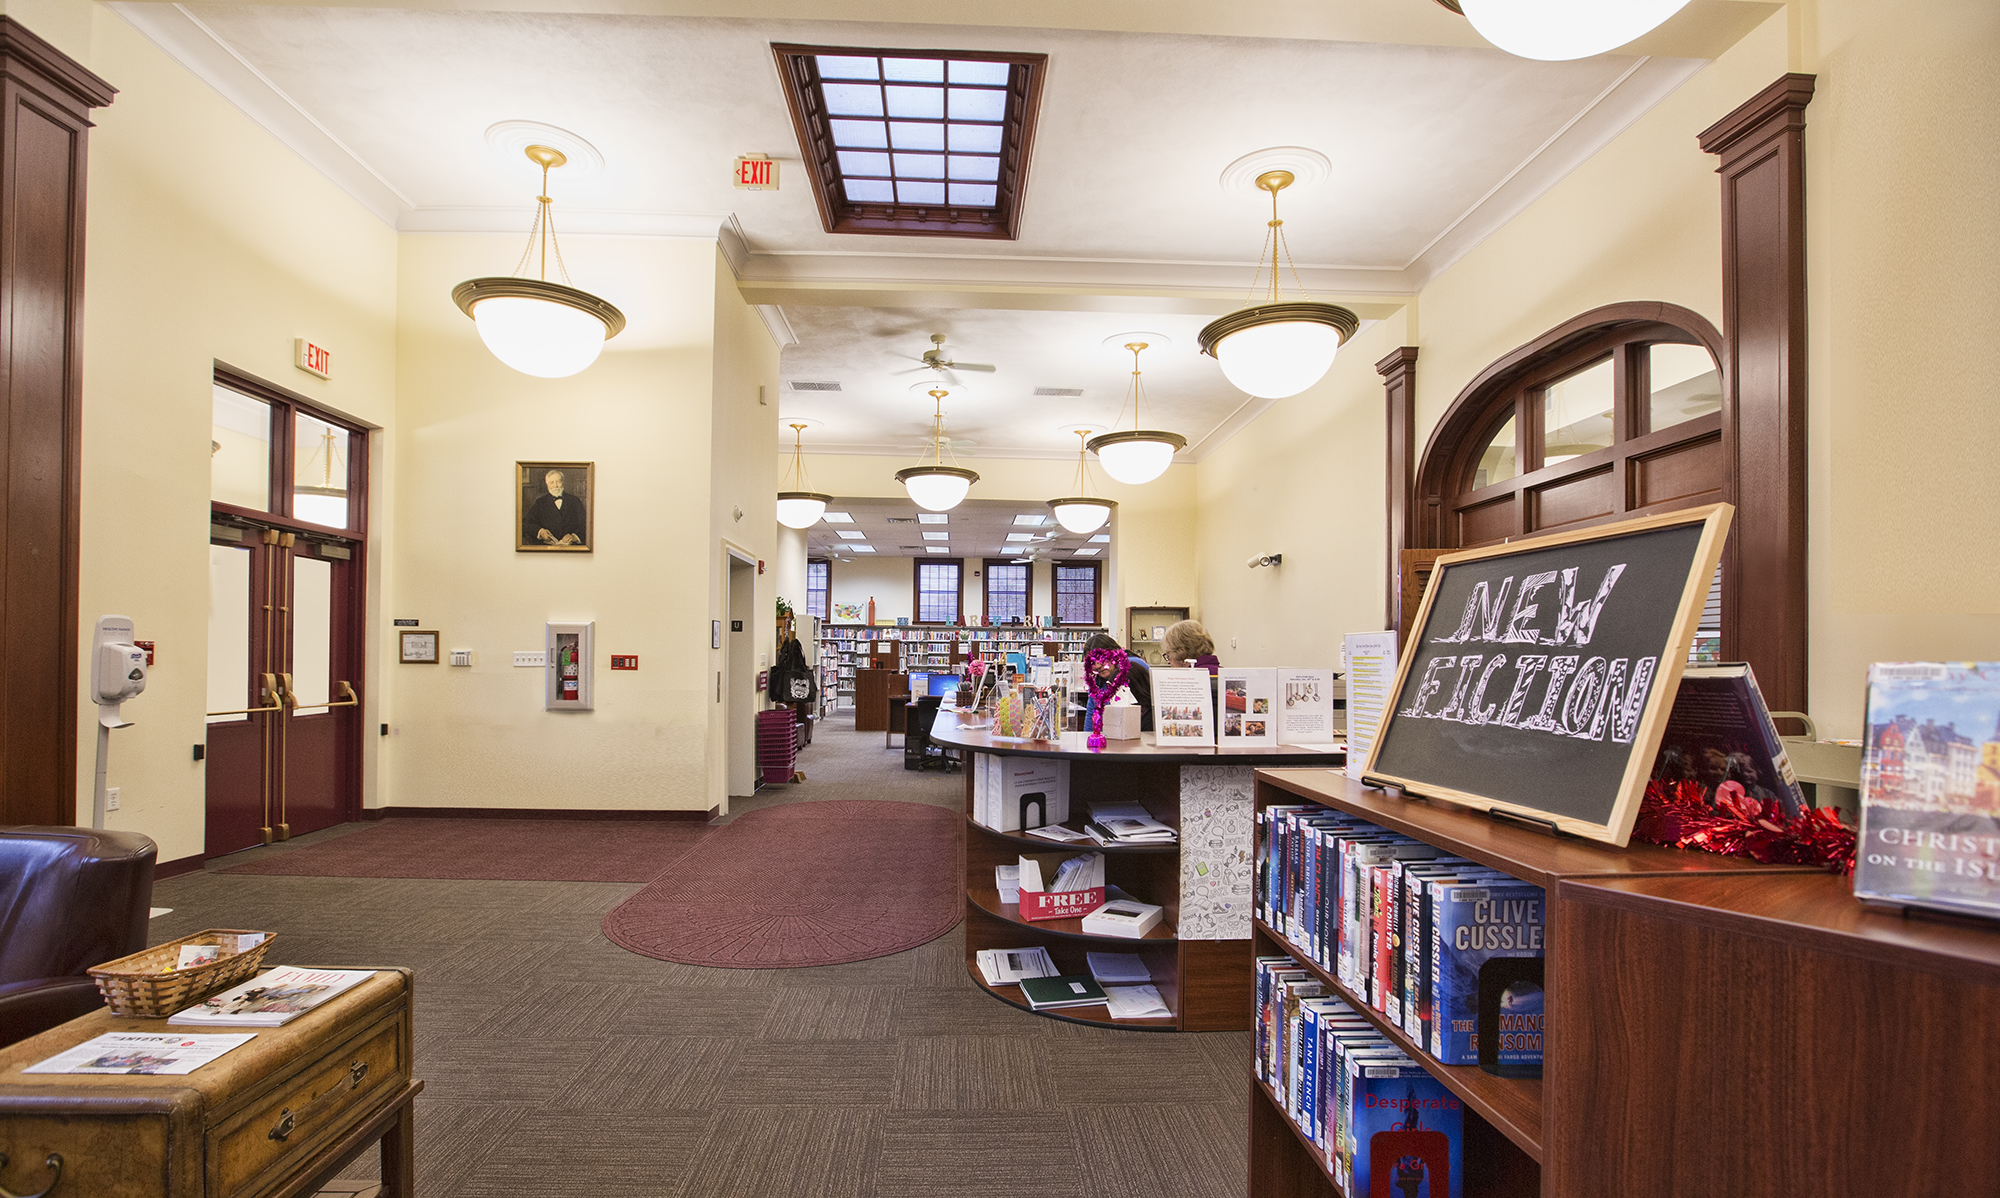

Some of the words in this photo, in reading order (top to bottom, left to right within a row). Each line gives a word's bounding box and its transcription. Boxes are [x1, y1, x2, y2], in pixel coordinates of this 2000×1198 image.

[742, 161, 772, 184] EXIT
[308, 343, 329, 375] EXIT
[1433, 563, 1627, 646] NEW
[945, 615, 1001, 627] LARGE
[1011, 615, 1063, 627] PRINT
[1398, 654, 1656, 743] FICTION
[1867, 854, 1896, 866] ON
[1904, 857, 1946, 873] THE
[1038, 892, 1096, 908] FREE
[1432, 899, 1440, 925] LIVE
[1474, 900, 1539, 924] CLIVE
[1412, 918, 1420, 973] CUSSLER
[1455, 925, 1545, 950] CUSSLE
[1431, 926, 1440, 983] CUSSLER
[1452, 1020, 1474, 1032] THE
[1365, 1093, 1459, 1112] Desperate
[1391, 1122, 1431, 1132] Girls
